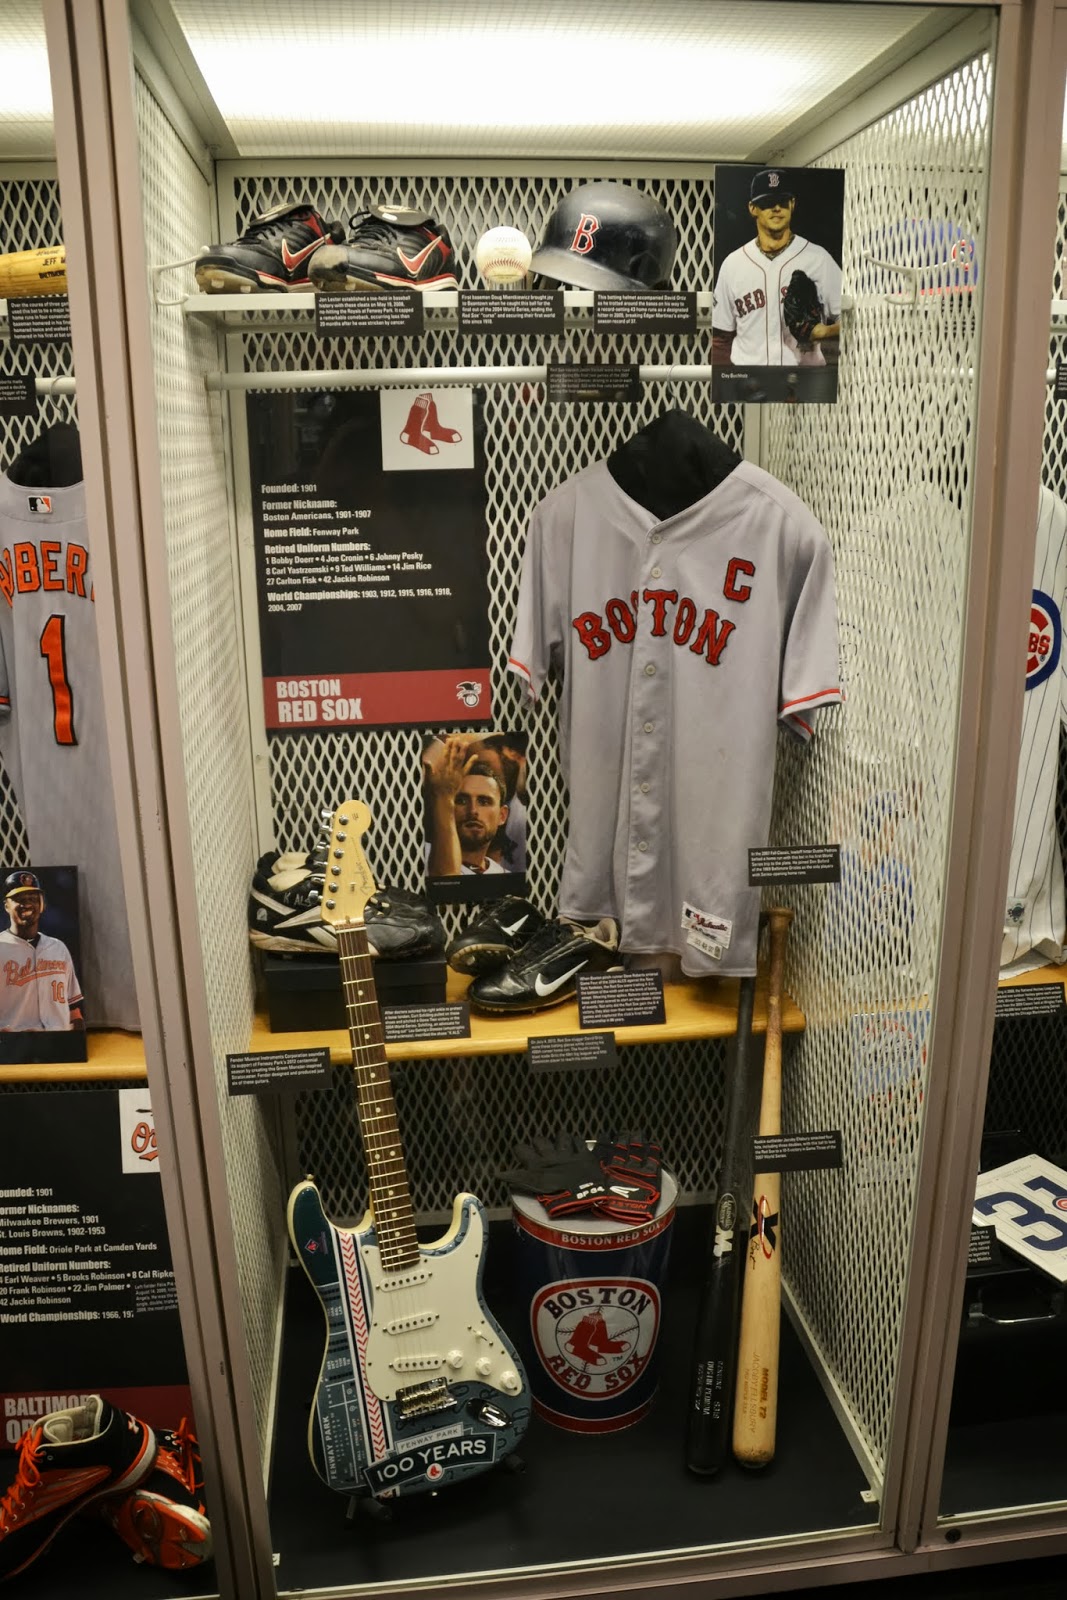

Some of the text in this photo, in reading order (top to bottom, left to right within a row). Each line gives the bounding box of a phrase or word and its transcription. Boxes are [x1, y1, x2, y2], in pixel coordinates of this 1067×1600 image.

[570, 213, 599, 254] B
[43, 257, 57, 266] JEFF
[735, 289, 765, 318] RED
[262, 483, 317, 493] Founded: 1901
[262, 500, 337, 510] Former Nickname:
[263, 510, 371, 521] Boston Americans, 1901-1907
[264, 527, 359, 538] Home Field: Fenway Park
[265, 542, 371, 554] Retired Uniform Numbers:
[271, 556, 293, 566] Bobby
[326, 555, 340, 563] Joe
[341, 554, 363, 562] Cronin
[376, 553, 400, 562] Johnny
[402, 552, 423, 561] Pesky
[266, 567, 270, 575] 8
[288, 565, 329, 575] Yastrzemski
[341, 564, 353, 572] Ted
[355, 563, 386, 571] Williams
[416, 562, 432, 570] Rice
[276, 577, 301, 585] Carlton
[302, 576, 317, 584] Fisk
[333, 575, 356, 583] Jackie
[357, 574, 390, 582] Robinson
[723, 557, 756, 604] C
[267, 588, 452, 601] World Championships: 1903, 1912, 1915, 1916, 1918,
[268, 604, 302, 613] 2004, 2007
[1028, 633, 1050, 655] BS
[40, 614, 78, 746] 1
[276, 679, 341, 698] BOSTON
[278, 698, 363, 722] RED SOX
[51, 980, 65, 1004] 10
[36, 1188, 53, 1196] 1901
[28, 1204, 79, 1213] Nicknames:
[43, 1216, 80, 1226] Brewers,
[82, 1215, 99, 1224] 1901
[9, 1229, 30, 1238] Louis
[32, 1228, 65, 1237] Browns,
[67, 1226, 106, 1236] 1902-1953
[561, 1222, 661, 1245] BOSTON RED SOX
[24, 1245, 48, 1255] Field:
[49, 1245, 73, 1254] Oriole
[75, 1245, 92, 1253] Park
[104, 1243, 134, 1252] Camden
[136, 1242, 157, 1250] Yards
[0, 1261, 111, 1272] Retired Uniform Numbers:
[4, 1275, 20, 1283] Earl
[21, 1274, 50, 1283] Weaver
[57, 1274, 61, 1282] 5
[63, 1273, 89, 1281] Brooks
[91, 1272, 125, 1280] Robinson
[132, 1271, 137, 1279] 8
[138, 1271, 151, 1279] Cal
[152, 1270, 175, 1278] Ripke
[9, 1285, 30, 1294] Frank
[32, 1285, 66, 1293] Robinson
[73, 1284, 81, 1292] 22
[83, 1283, 97, 1291] Jim
[99, 1283, 125, 1291] Palmer
[10, 1297, 36, 1306] Jackie
[37, 1296, 71, 1304] Robinson
[543, 1287, 651, 1320] BOSTON
[1, 1313, 27, 1324] World
[29, 1311, 100, 1322] Championships:
[102, 1311, 121, 1320] 1966,
[546, 1351, 645, 1391] RED SOX
[760, 1367, 769, 1403] MODEL
[4, 1394, 100, 1417] BALTIMO
[401, 1429, 458, 1450] FENWAY PARK
[322, 1415, 337, 1479] FENWAY PARK
[377, 1457, 414, 1482] 100
[418, 1439, 486, 1464] YEARS
